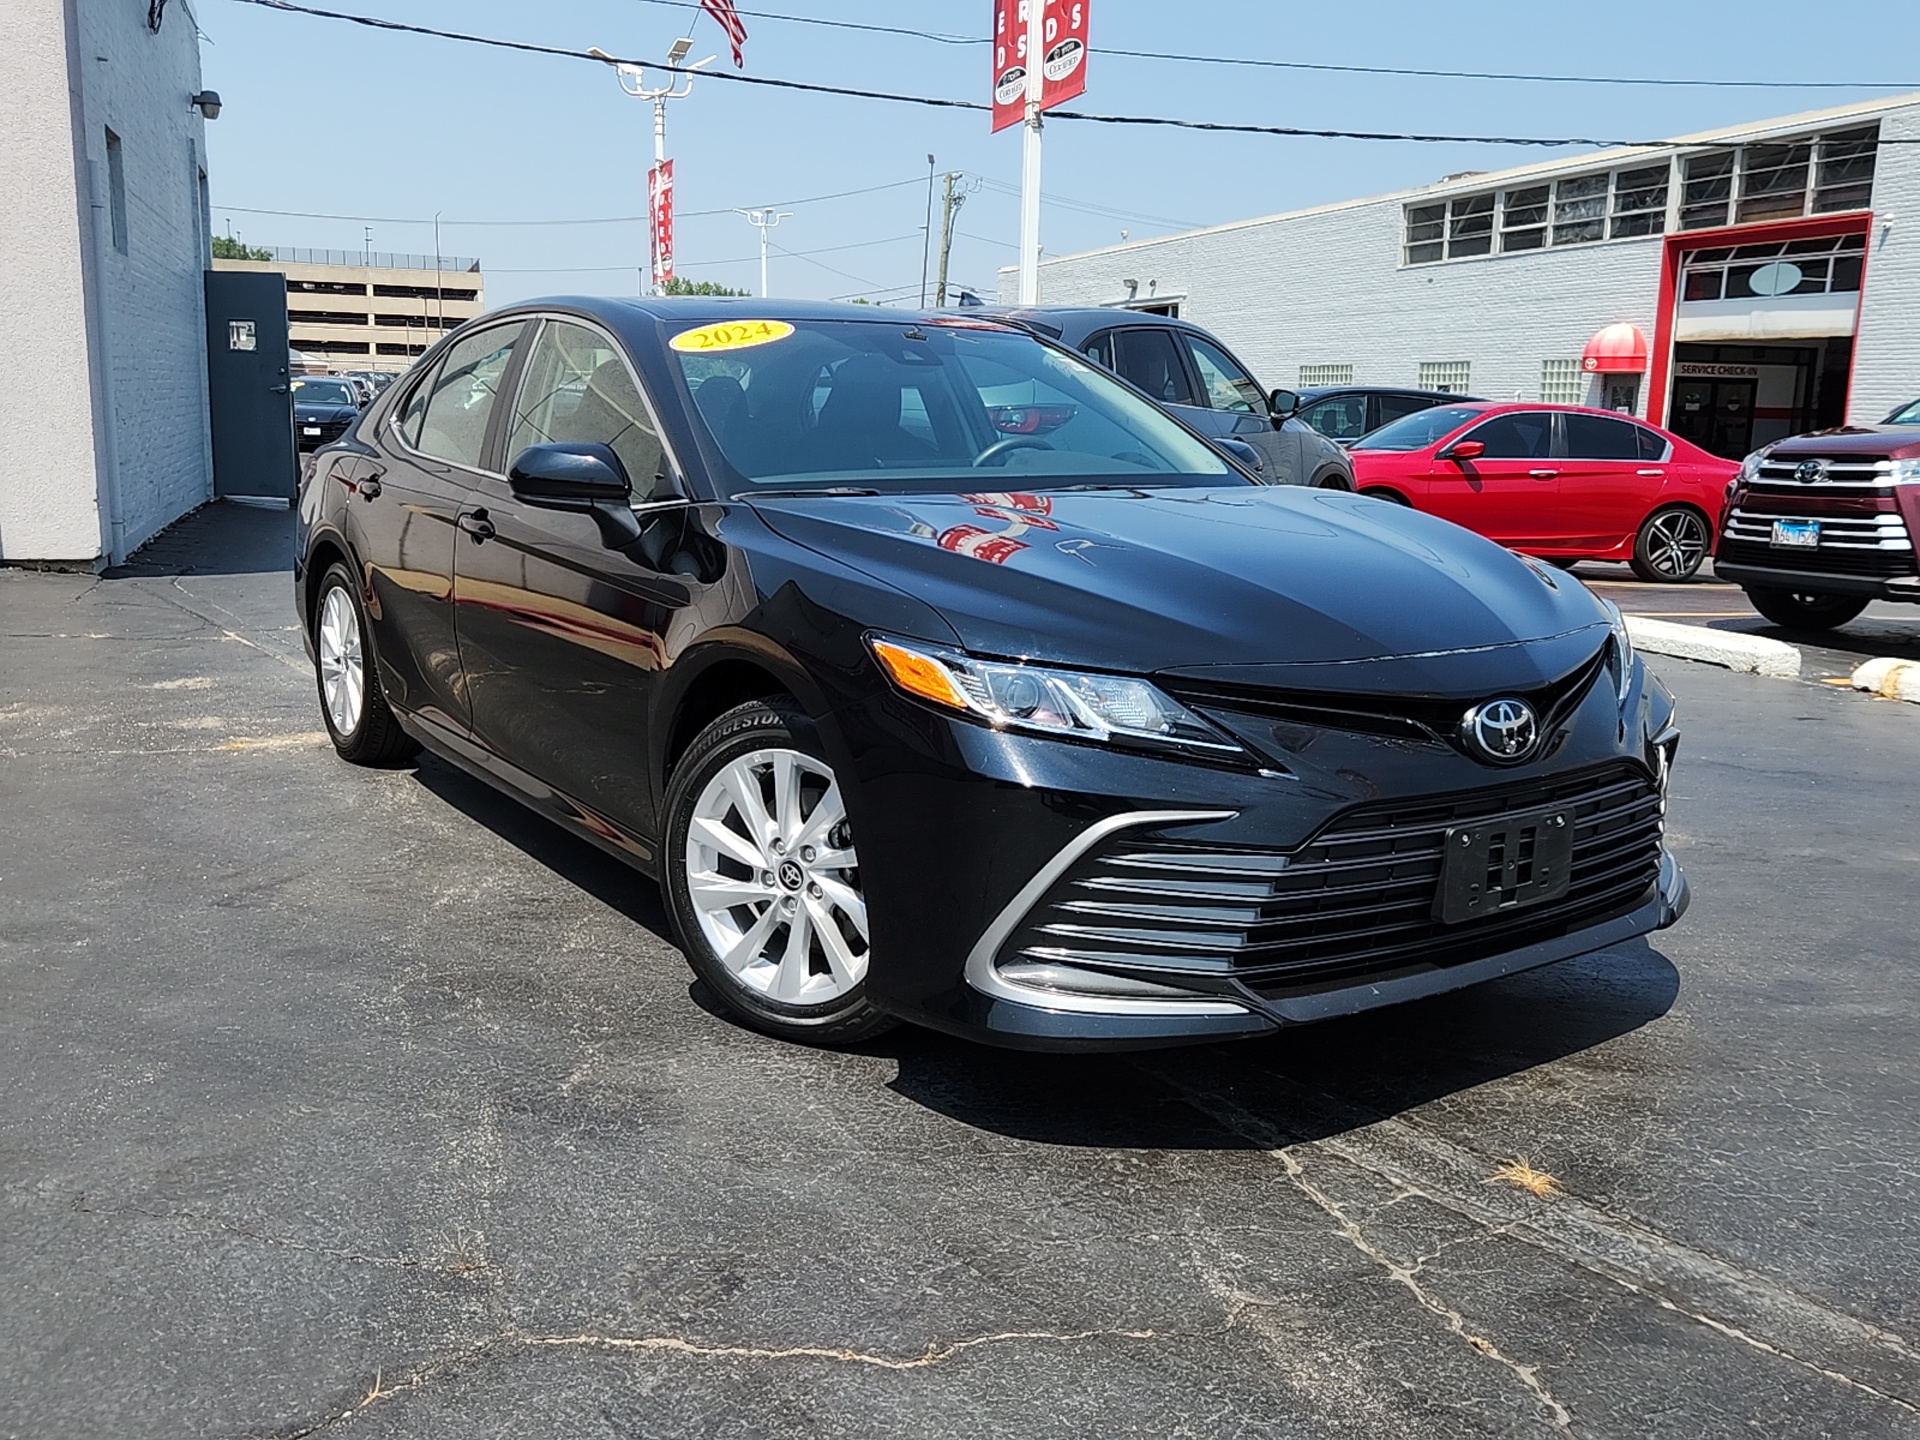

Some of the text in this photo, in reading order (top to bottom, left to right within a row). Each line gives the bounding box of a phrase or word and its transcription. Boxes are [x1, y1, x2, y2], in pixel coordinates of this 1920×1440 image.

[693, 322, 773, 348] 2024
[1681, 364, 1758, 376] SERVICE CHECK-IN
